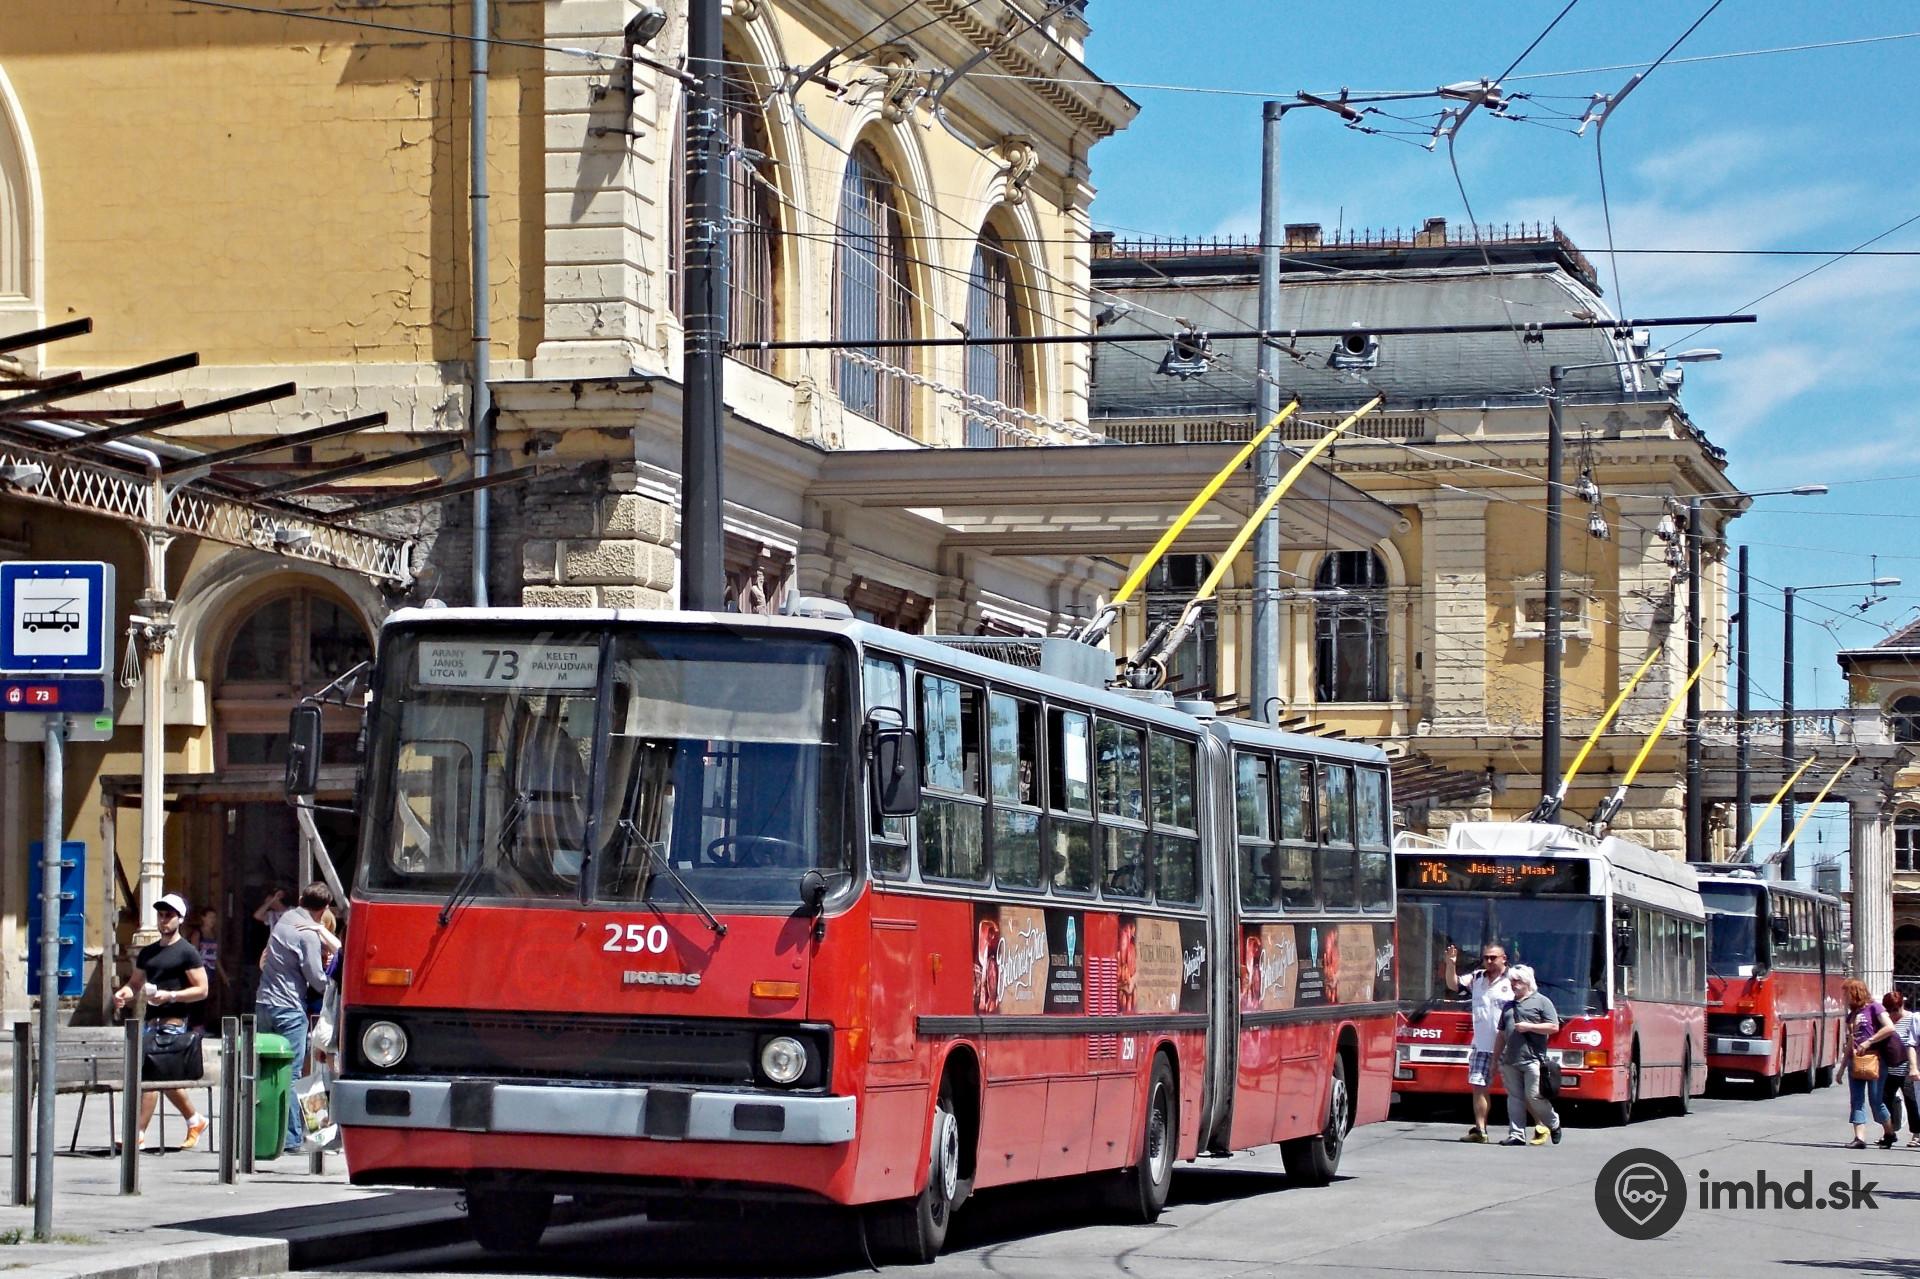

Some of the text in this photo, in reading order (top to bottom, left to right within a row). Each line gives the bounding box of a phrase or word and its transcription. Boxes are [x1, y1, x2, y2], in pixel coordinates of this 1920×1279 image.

[432, 649, 466, 658] ARANY
[546, 651, 578, 661] KELETI
[481, 649, 520, 681] 73
[430, 669, 467, 678] UTCA M
[557, 672, 568, 681] M
[36, 690, 49, 701] 73
[1419, 861, 1448, 883] 76
[603, 923, 668, 954] 250
[623, 970, 702, 987] IKARUS
[1122, 1036, 1135, 1060] 250
